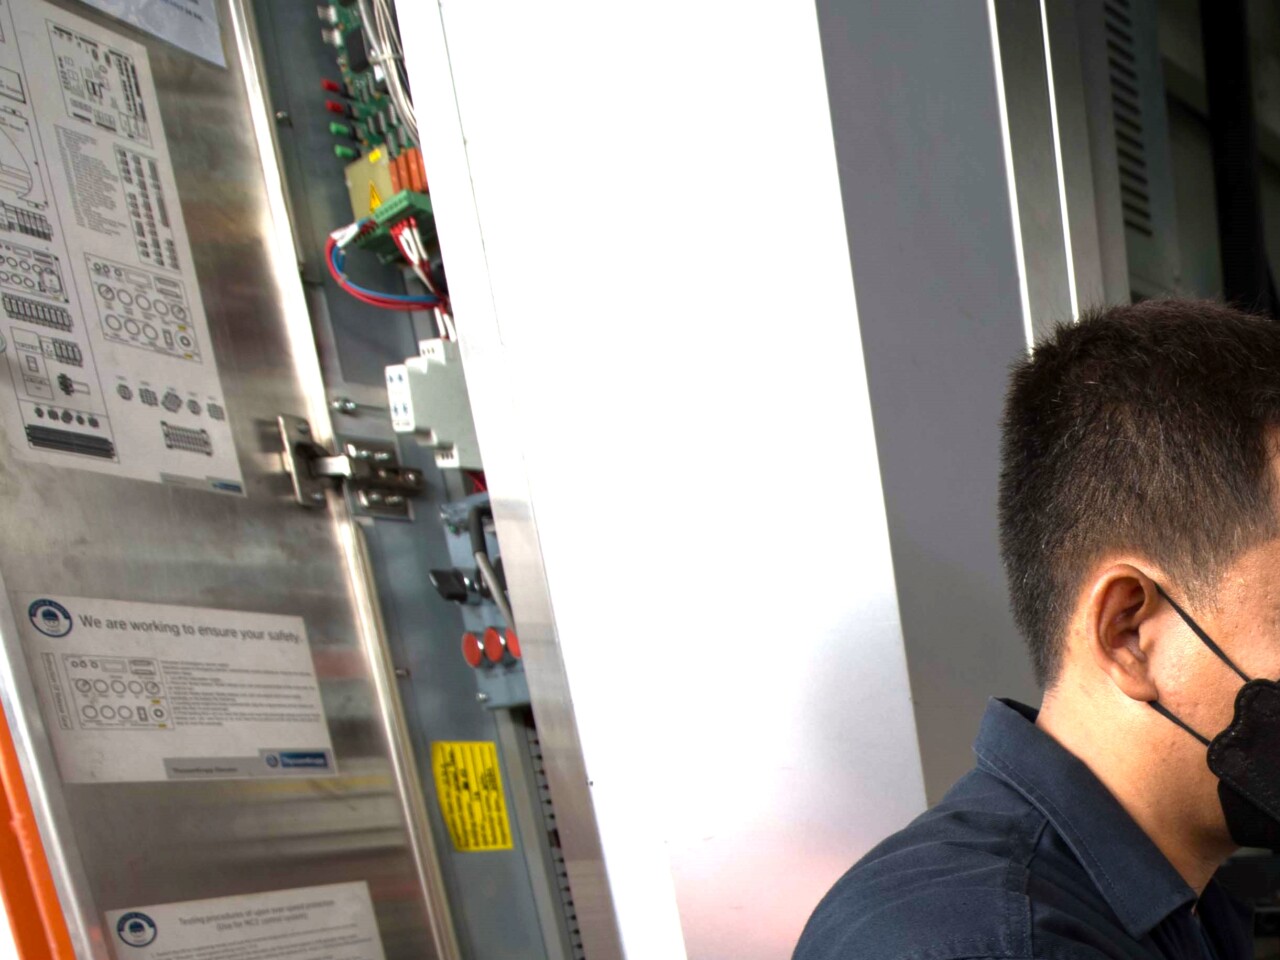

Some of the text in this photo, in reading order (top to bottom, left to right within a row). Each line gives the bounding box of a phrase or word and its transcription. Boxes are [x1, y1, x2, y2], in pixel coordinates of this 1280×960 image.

[79, 614, 101, 629] We
[106, 619, 127, 631] are
[131, 620, 180, 637] working
[183, 624, 195, 635] to
[198, 626, 238, 638] ensure
[241, 630, 264, 641] your
